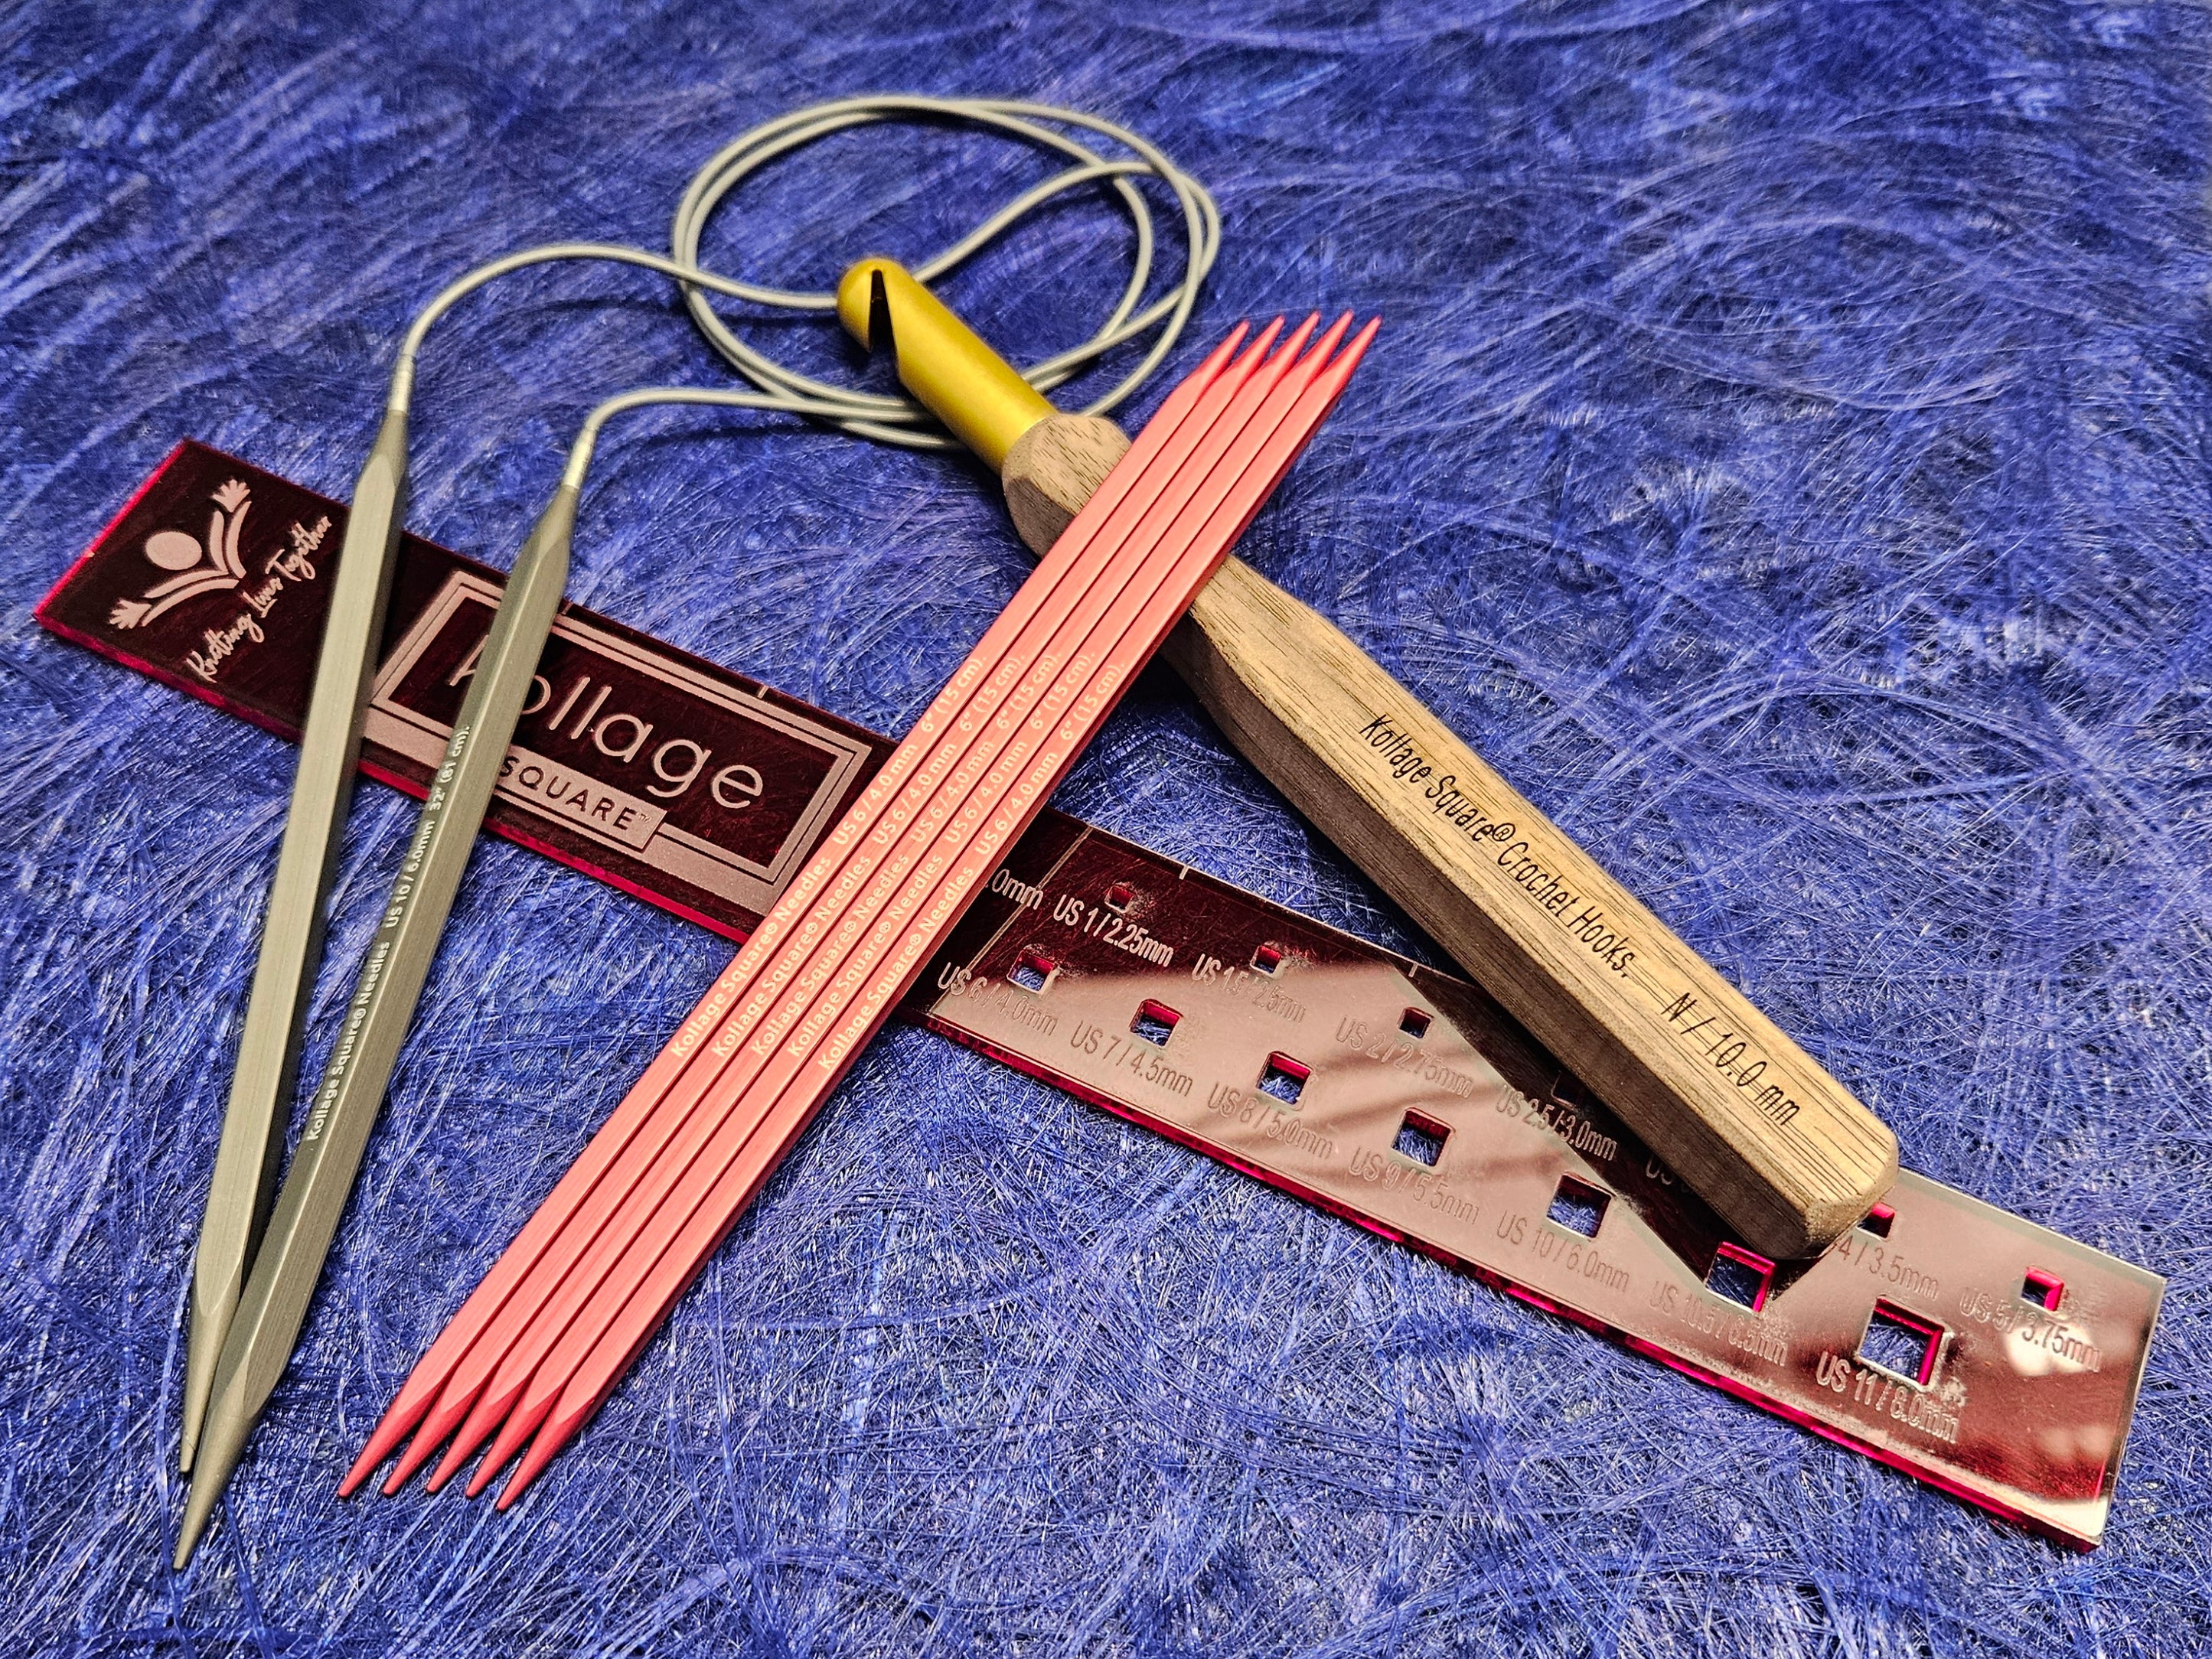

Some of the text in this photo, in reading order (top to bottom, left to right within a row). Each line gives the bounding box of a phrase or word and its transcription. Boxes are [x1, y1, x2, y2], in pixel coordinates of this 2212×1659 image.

[265, 515, 332, 582] Together
[670, 992, 726, 1057] Kollage
[773, 856, 830, 921] Needles
[831, 820, 856, 845] US
[853, 809, 866, 822] 6
[869, 774, 893, 800] 4.0
[889, 744, 918, 774] mm
[934, 686, 959, 714] (15
[956, 657, 987, 687] cm).
[711, 992, 768, 1057] Kollage
[814, 856, 870, 921] Needles
[871, 820, 896, 844] US
[892, 808, 905, 820] 6
[909, 774, 931, 799] 4.0
[928, 743, 957, 774] mm
[972, 686, 997, 712] (15
[995, 655, 1025, 686] cm).
[750, 991, 810, 1055] Kollage
[852, 855, 909, 920] Needles
[909, 818, 934, 842] US
[929, 806, 944, 819] 6
[946, 771, 969, 797] 4.0
[966, 741, 995, 772] mm
[1009, 683, 1034, 710] (15
[1032, 653, 1061, 683] cm).
[786, 992, 846, 1057] Kollage
[887, 854, 943, 921] Needles
[944, 820, 967, 843] US
[964, 807, 977, 819] 6
[980, 772, 1003, 797] 4.0
[1000, 741, 1027, 772] mm
[1042, 683, 1068, 710] (15
[1065, 653, 1095, 683] cm).
[817, 1005, 873, 1070] Kollage
[918, 866, 974, 933] Needles
[974, 830, 998, 854] US
[994, 818, 1007, 830] 6
[1011, 783, 1033, 809] 4.0
[1030, 752, 1058, 784] mm
[1073, 694, 1098, 721] (15
[1096, 663, 1124, 694] cm).
[984, 867, 1045, 909] .0mm
[307, 1080, 338, 1139] Kollage
[357, 942, 389, 1005] Needles
[385, 906, 402, 927] US
[396, 885, 410, 902] 10
[407, 820, 435, 872] 6.0mm
[439, 762, 455, 783] (81
[452, 726, 469, 756] cm).
[1052, 893, 1086, 926] US
[1081, 906, 1098, 932] 1
[1103, 916, 1173, 966] 2.25mm
[1359, 714, 1431, 782] Kollage
[1497, 842, 1579, 917] Crochet
[1566, 906, 1635, 977] Hooks.
[1662, 992, 1697, 1021] N
[1709, 1032, 1767, 1086] 10.0
[1754, 1085, 1799, 1125] mm
[938, 961, 974, 996] US
[966, 974, 987, 1002] 6
[990, 986, 1057, 1035] 4.0mm
[1070, 1020, 1105, 1054] US
[1101, 1034, 1122, 1063] 7
[1128, 1047, 1193, 1096] 4.5mm
[1336, 1015, 1371, 1050] US
[1367, 1028, 1388, 1058] 2
[1394, 1040, 1473, 1097] 2.75mm
[1207, 1080, 1241, 1116] US
[1238, 1095, 1258, 1125] 8
[1264, 1107, 1333, 1160] 5.0mm
[1496, 1084, 1525, 1119] US
[1520, 1096, 1555, 1133] 2.5
[1560, 1113, 1617, 1161] 3.0mm
[1349, 1144, 1387, 1183] US
[1379, 1158, 1401, 1191] 9
[1410, 1172, 1479, 1227] 5.5mm
[1497, 1210, 1529, 1245] US
[1529, 1225, 1551, 1256] 10
[1565, 1240, 1630, 1292] 6.0mm
[1838, 1234, 1850, 1263] 4
[1868, 1245, 1939, 1300] 3.5mm
[1960, 1284, 1995, 1324] US
[1992, 1299, 2011, 1331] 5
[2020, 1311, 2101, 1372] 3.75mm
